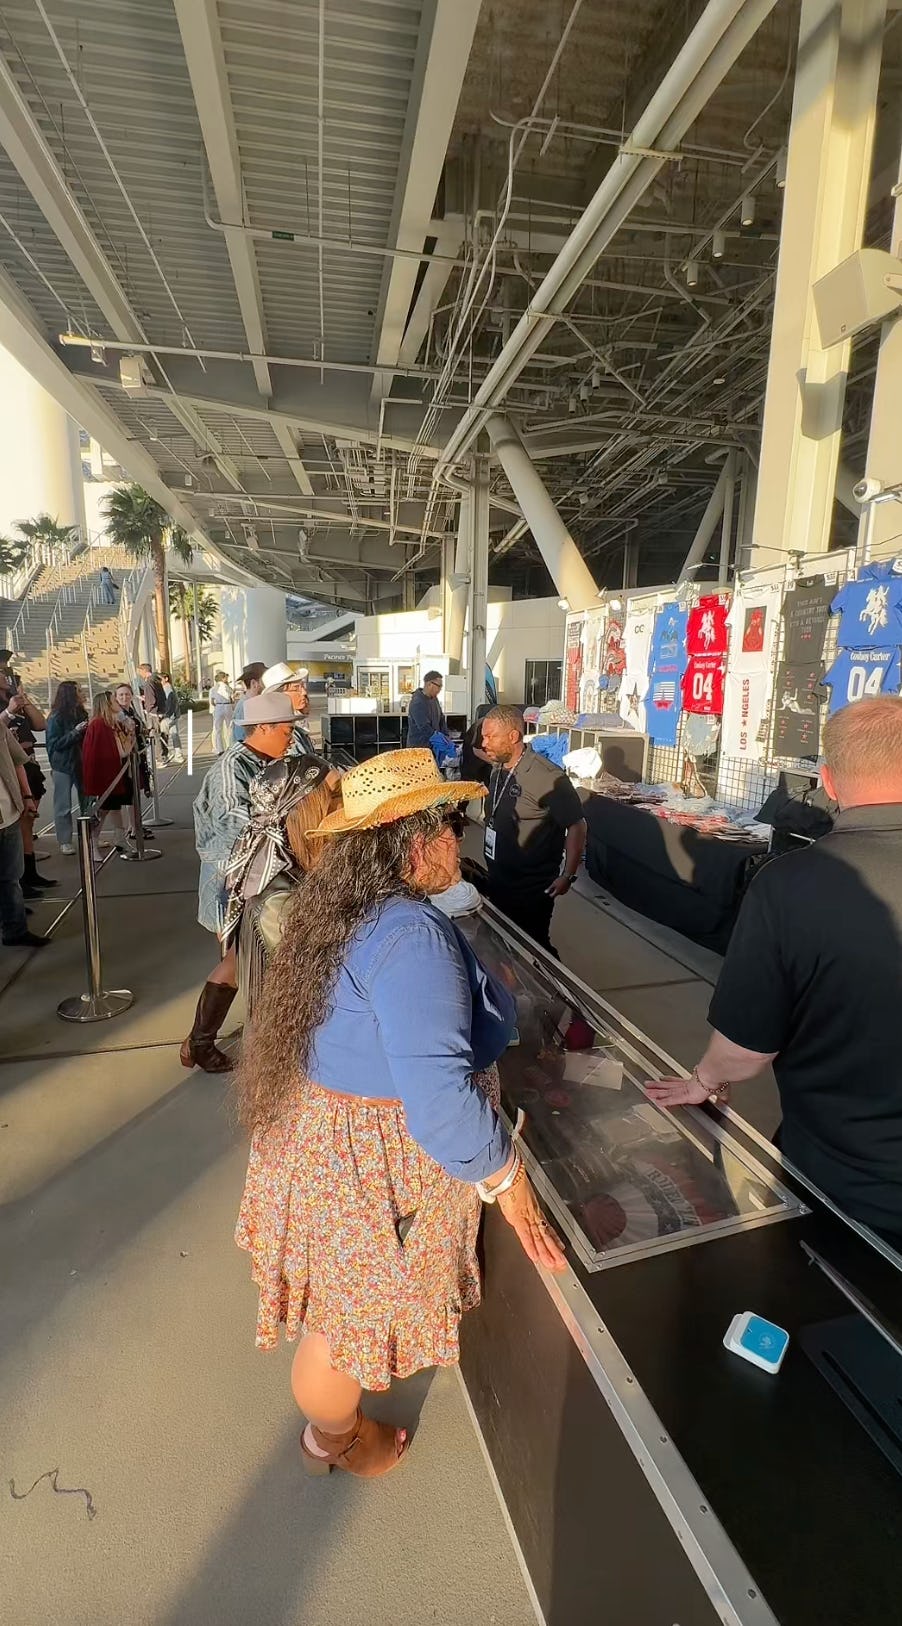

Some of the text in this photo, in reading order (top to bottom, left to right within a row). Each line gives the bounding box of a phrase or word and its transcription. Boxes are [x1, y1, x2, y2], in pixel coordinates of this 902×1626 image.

[634, 624, 645, 634] CC
[869, 651, 891, 661] Carter
[692, 672, 714, 701] 04
[847, 666, 884, 703] 04
[739, 732, 748, 750] LOS
